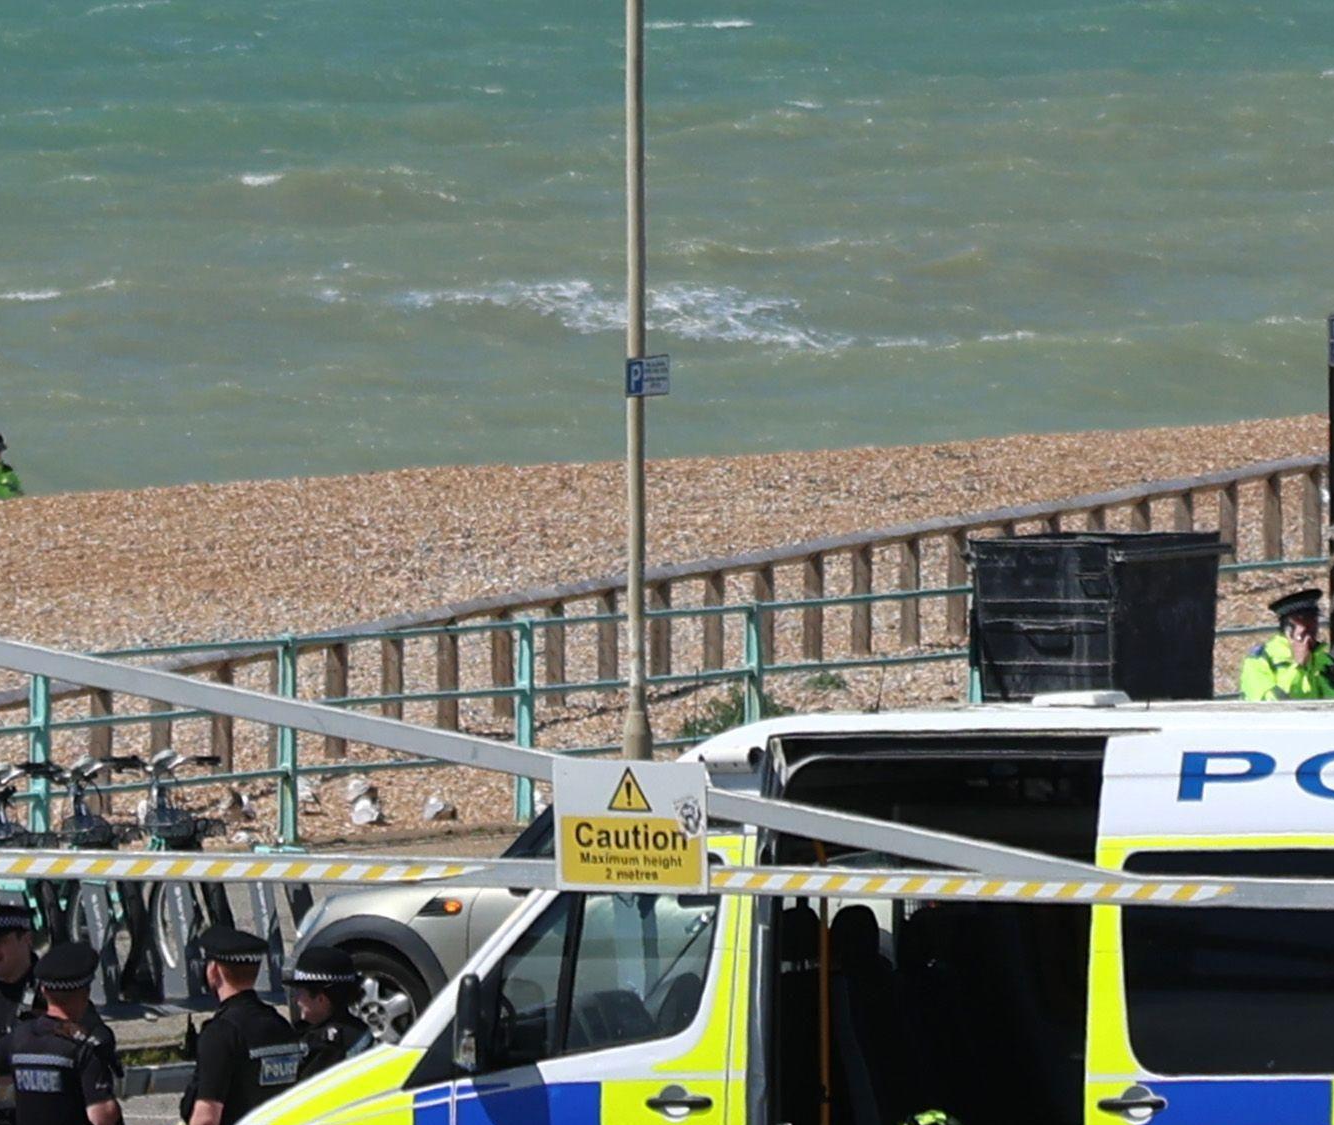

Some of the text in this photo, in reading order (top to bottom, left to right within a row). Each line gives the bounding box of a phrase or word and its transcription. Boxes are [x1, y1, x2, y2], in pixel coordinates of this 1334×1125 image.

[575, 822, 688, 851] Caution
[580, 852, 682, 871] Maximum height
[605, 868, 659, 881] 2 metres
[15, 1069, 61, 1092] POLICE
